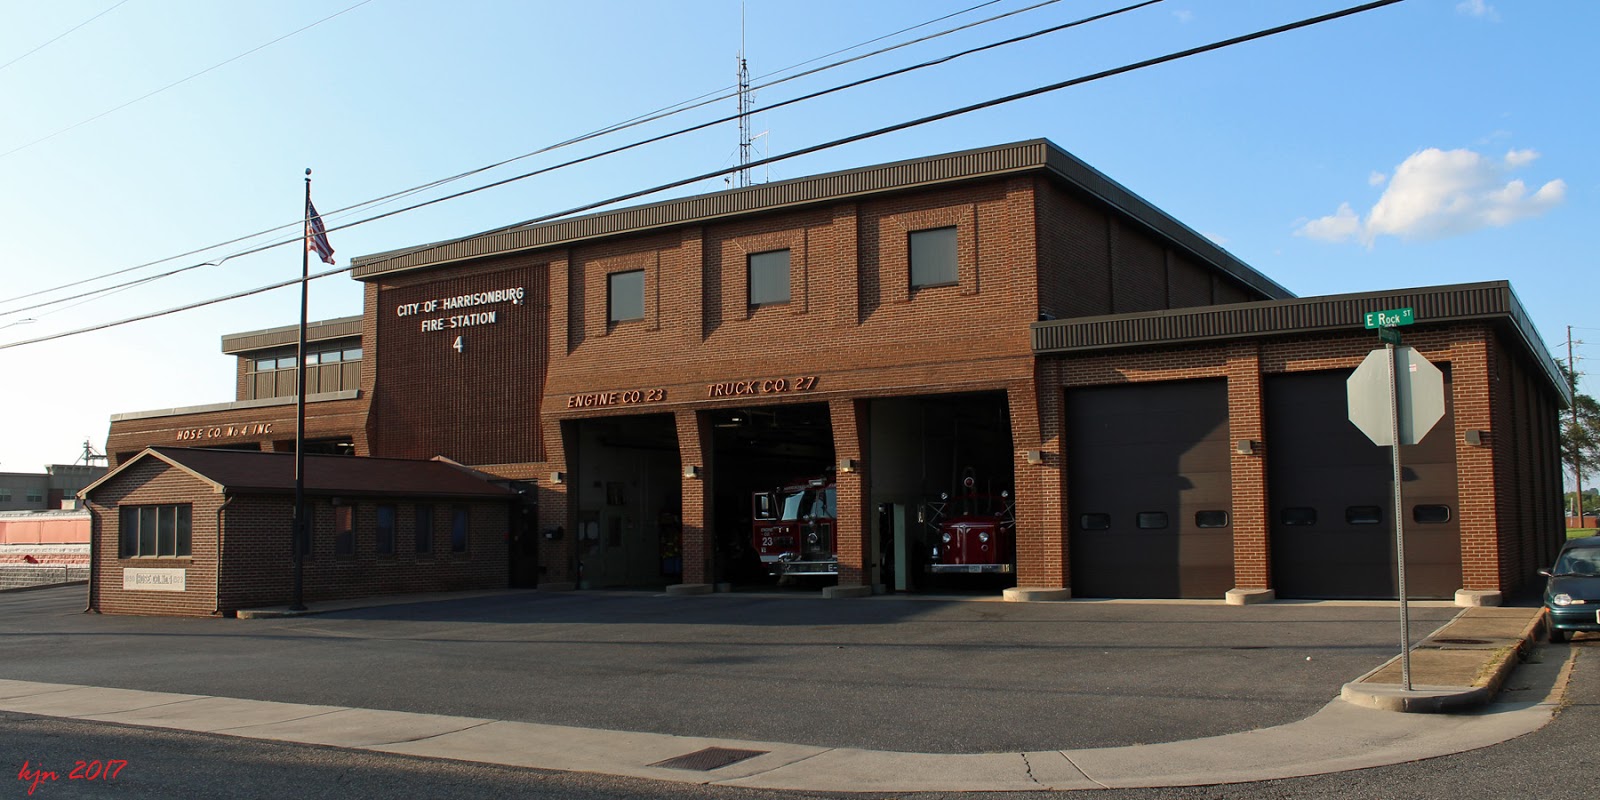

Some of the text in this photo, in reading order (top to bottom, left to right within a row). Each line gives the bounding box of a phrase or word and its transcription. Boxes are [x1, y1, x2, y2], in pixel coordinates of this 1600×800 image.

[397, 287, 524, 317] CITY OF HARRISONBURG
[421, 311, 496, 332] FIRE STATION
[1366, 314, 1374, 326] E
[1378, 313, 1400, 325] Rock
[452, 335, 463, 353] 4
[707, 377, 815, 397] TRUCK CO. 27
[567, 389, 664, 408] ENGINE CO. 23
[176, 429, 203, 440] HOSE
[208, 427, 221, 438] CO.
[241, 425, 248, 435] 4
[252, 424, 273, 434] INC.
[762, 537, 773, 546] 23
